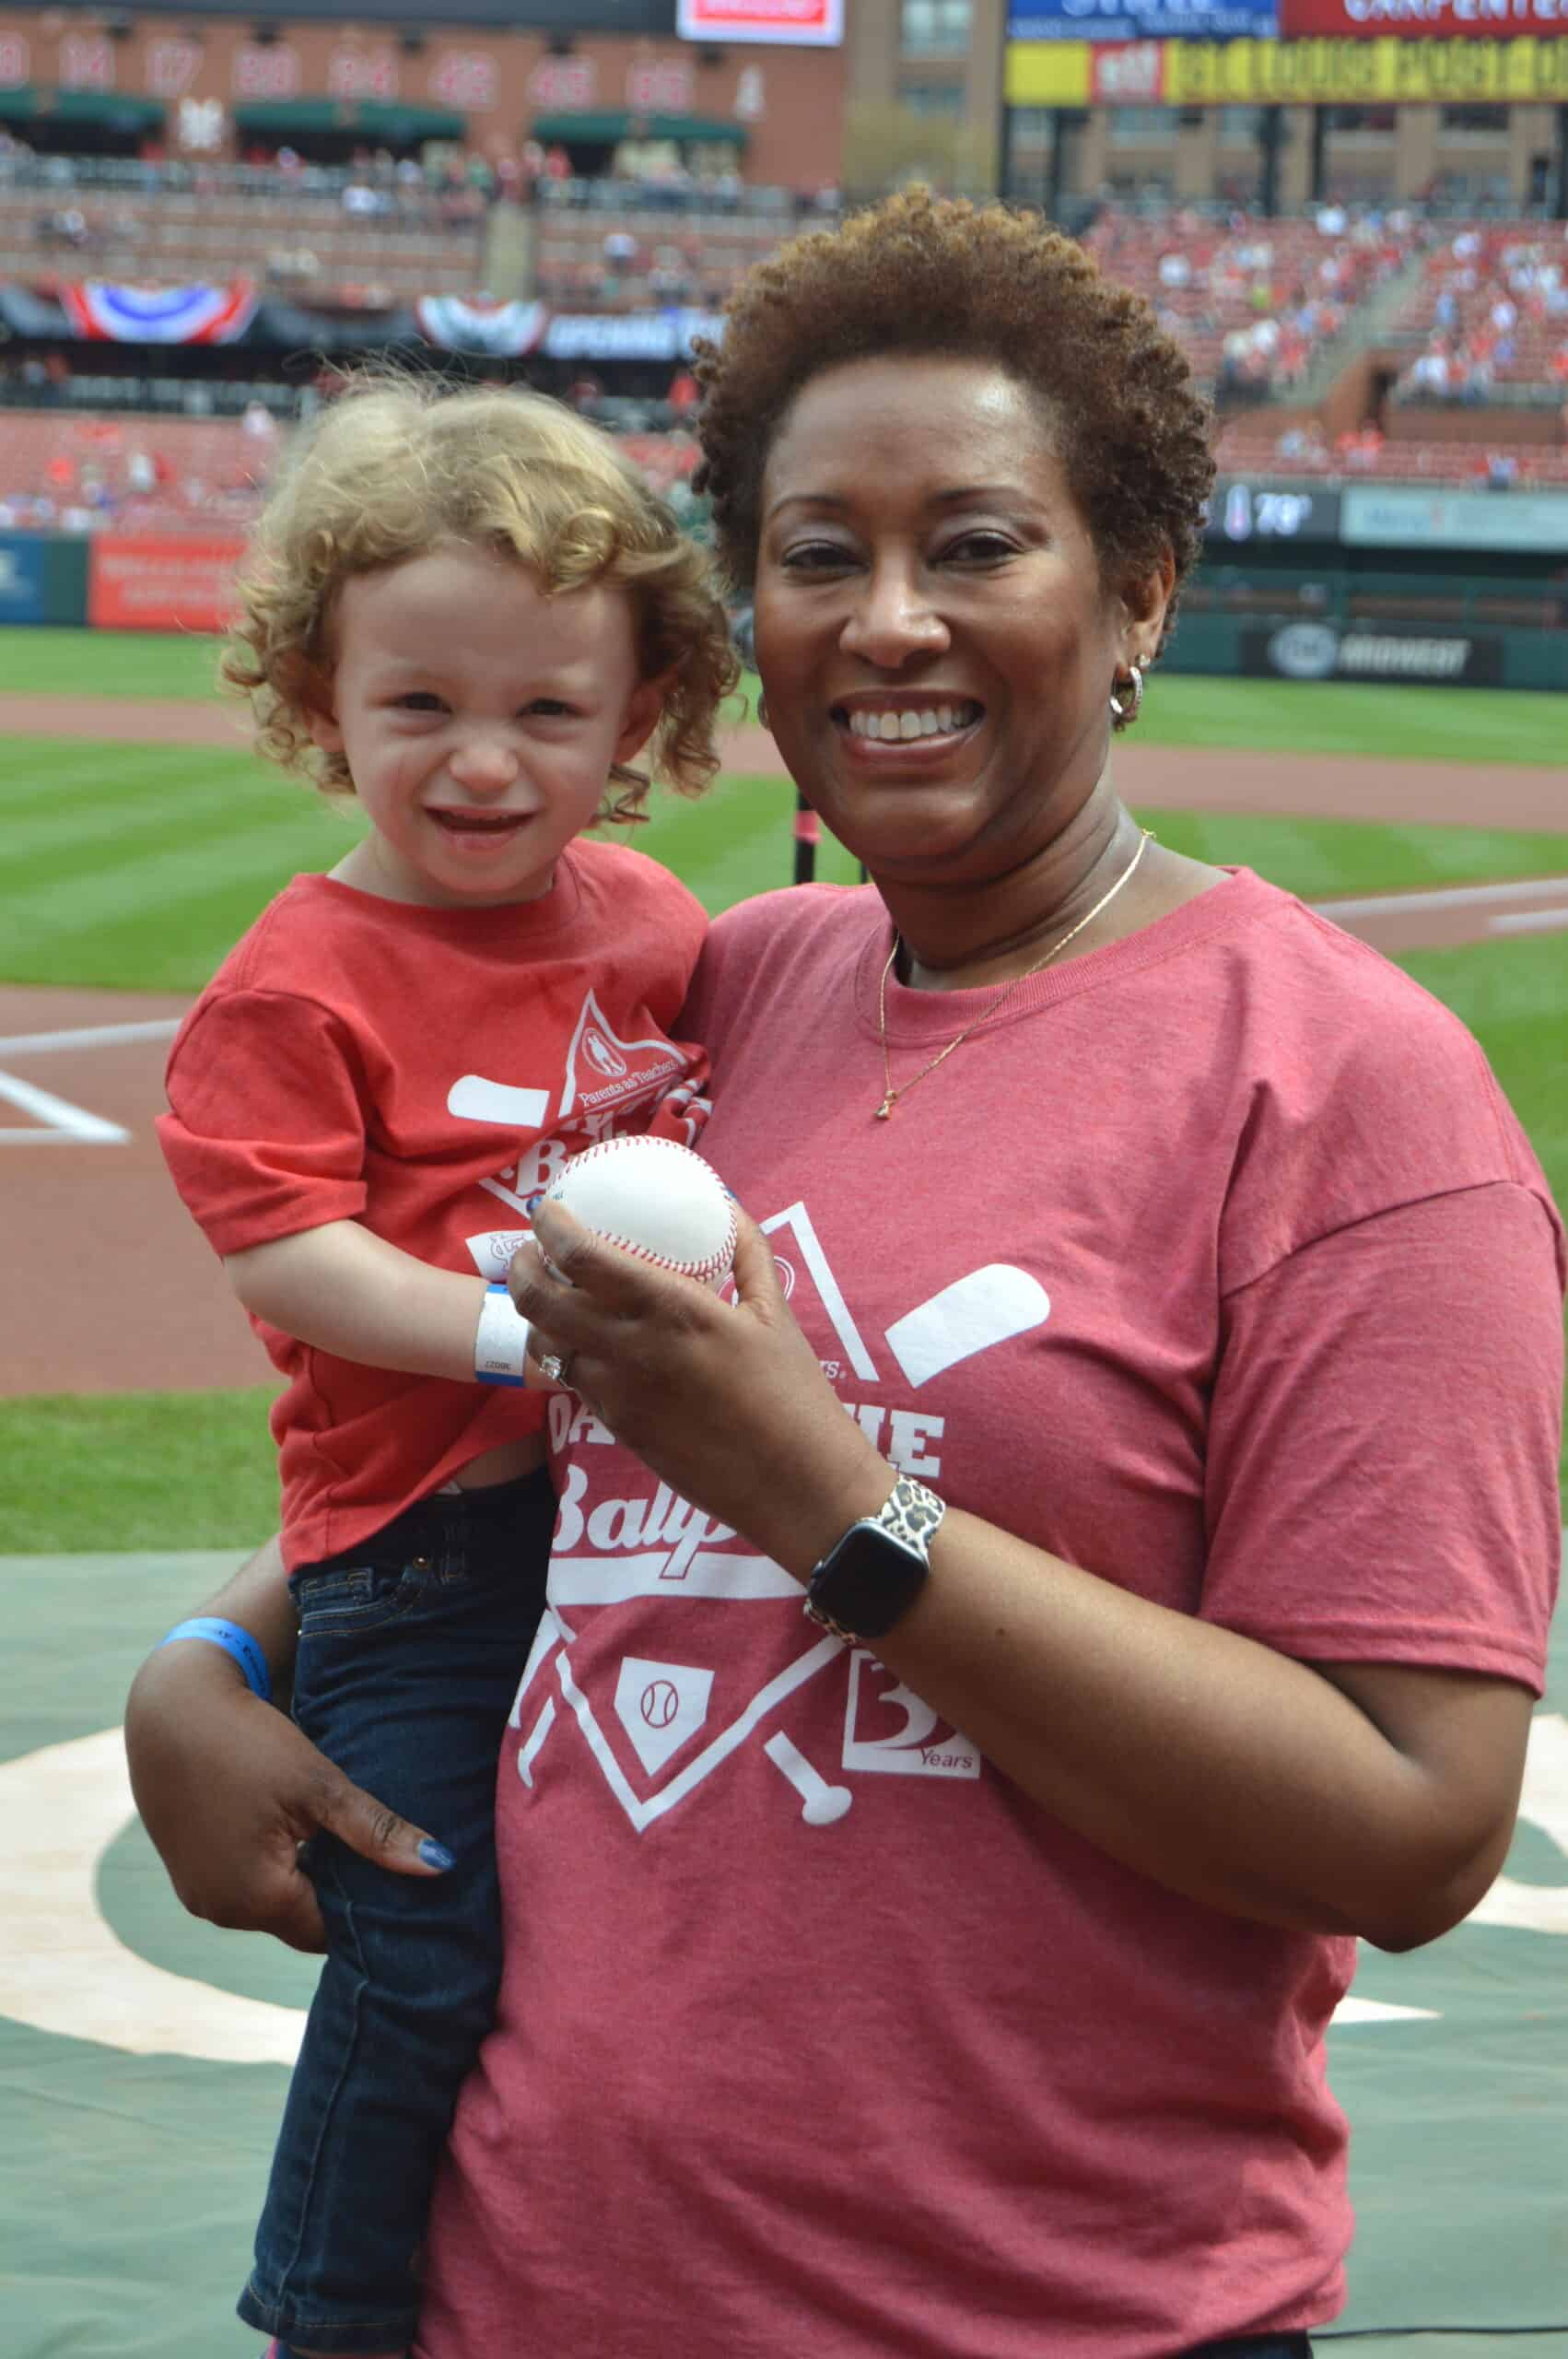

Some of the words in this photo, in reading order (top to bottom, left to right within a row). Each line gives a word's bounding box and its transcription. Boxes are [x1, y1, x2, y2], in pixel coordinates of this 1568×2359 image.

[578, 1082, 624, 1108] Parents
[551, 1462, 738, 1579] Ballp
[921, 1750, 974, 1770] Years
